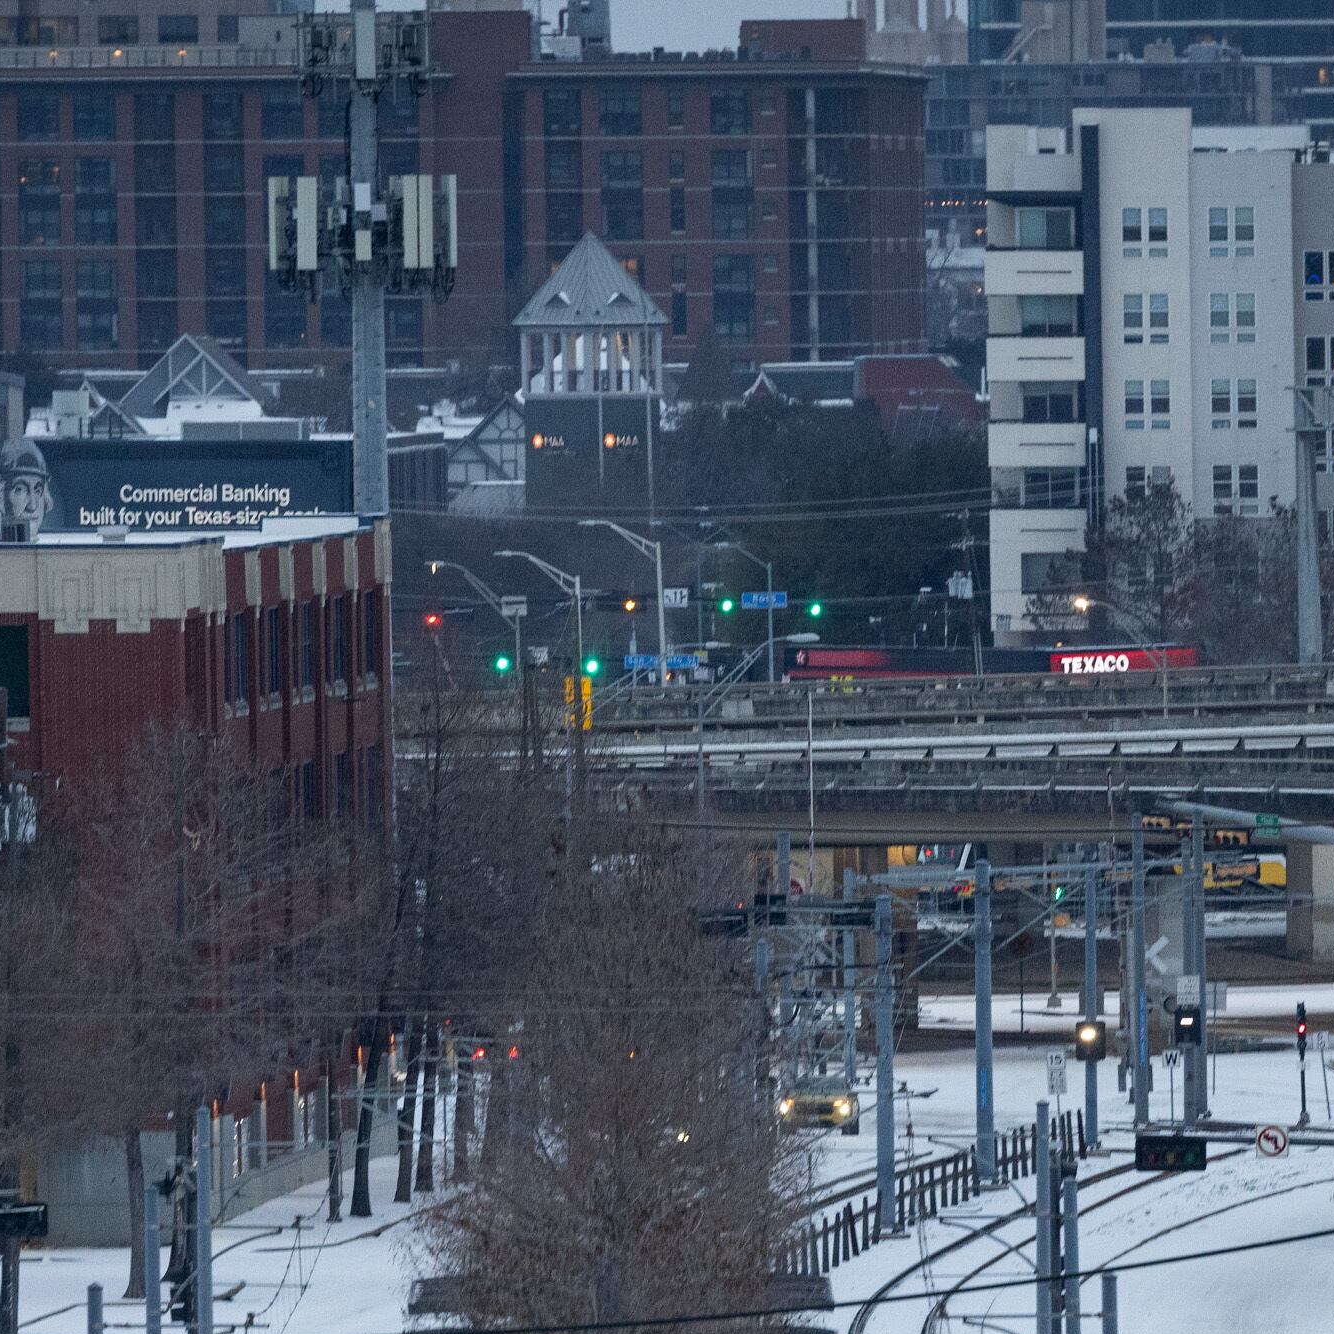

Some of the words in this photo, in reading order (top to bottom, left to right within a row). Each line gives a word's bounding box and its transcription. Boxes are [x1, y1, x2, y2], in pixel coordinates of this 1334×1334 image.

[119, 483, 218, 503] Commercial
[222, 483, 290, 506] Banking
[79, 506, 115, 525] built
[118, 506, 142, 525] for
[145, 510, 182, 529] your
[1061, 654, 1129, 674] TEXACO
[1165, 1052, 1177, 1065] W
